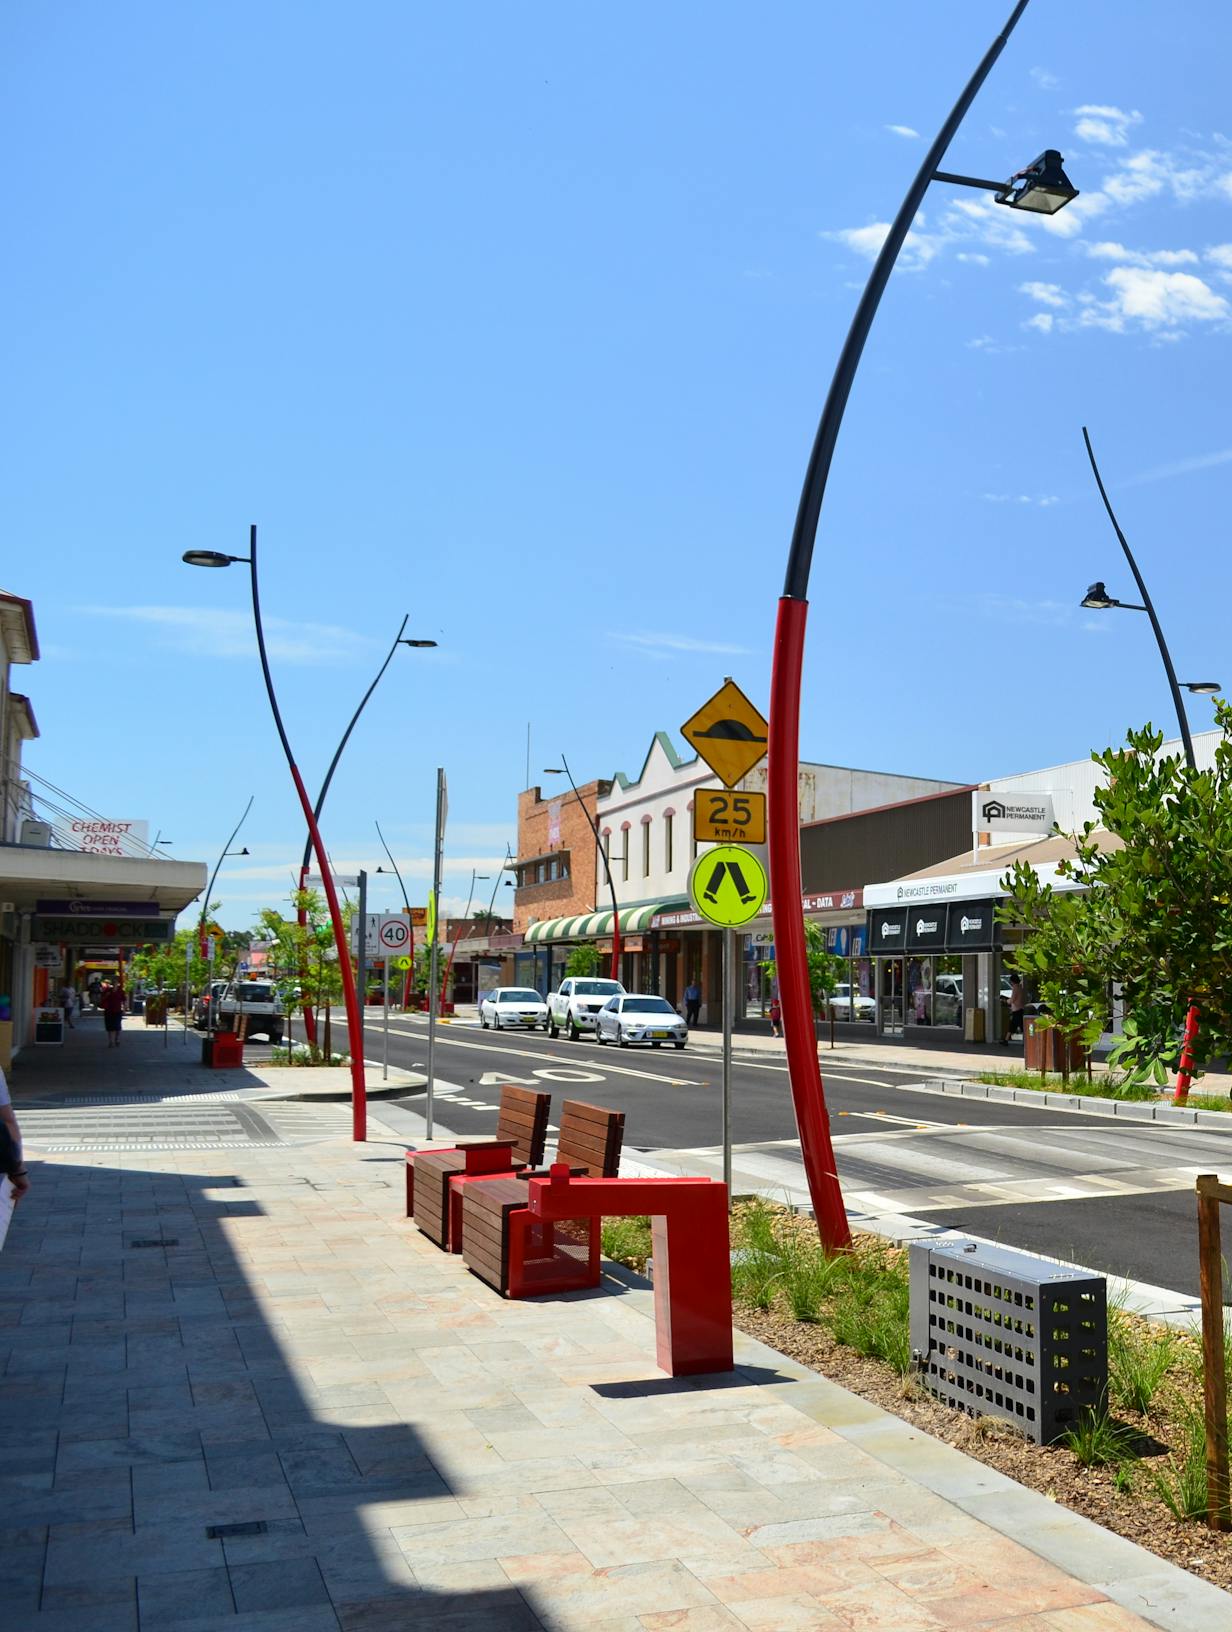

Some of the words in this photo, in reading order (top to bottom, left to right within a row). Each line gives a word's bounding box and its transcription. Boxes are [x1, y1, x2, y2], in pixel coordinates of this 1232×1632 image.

[709, 796, 752, 826] 25
[1006, 806, 1046, 814] NEWCASTLE
[1006, 813, 1045, 821] PERMANENT
[71, 822, 132, 834] CHEMIST
[714, 827, 746, 838] km/h
[83, 834, 120, 845] OPEN
[904, 886, 929, 897] NEWCASTLE
[930, 884, 957, 896] PERMANENT
[816, 896, 833, 908] DATA
[384, 927, 405, 941] 40
